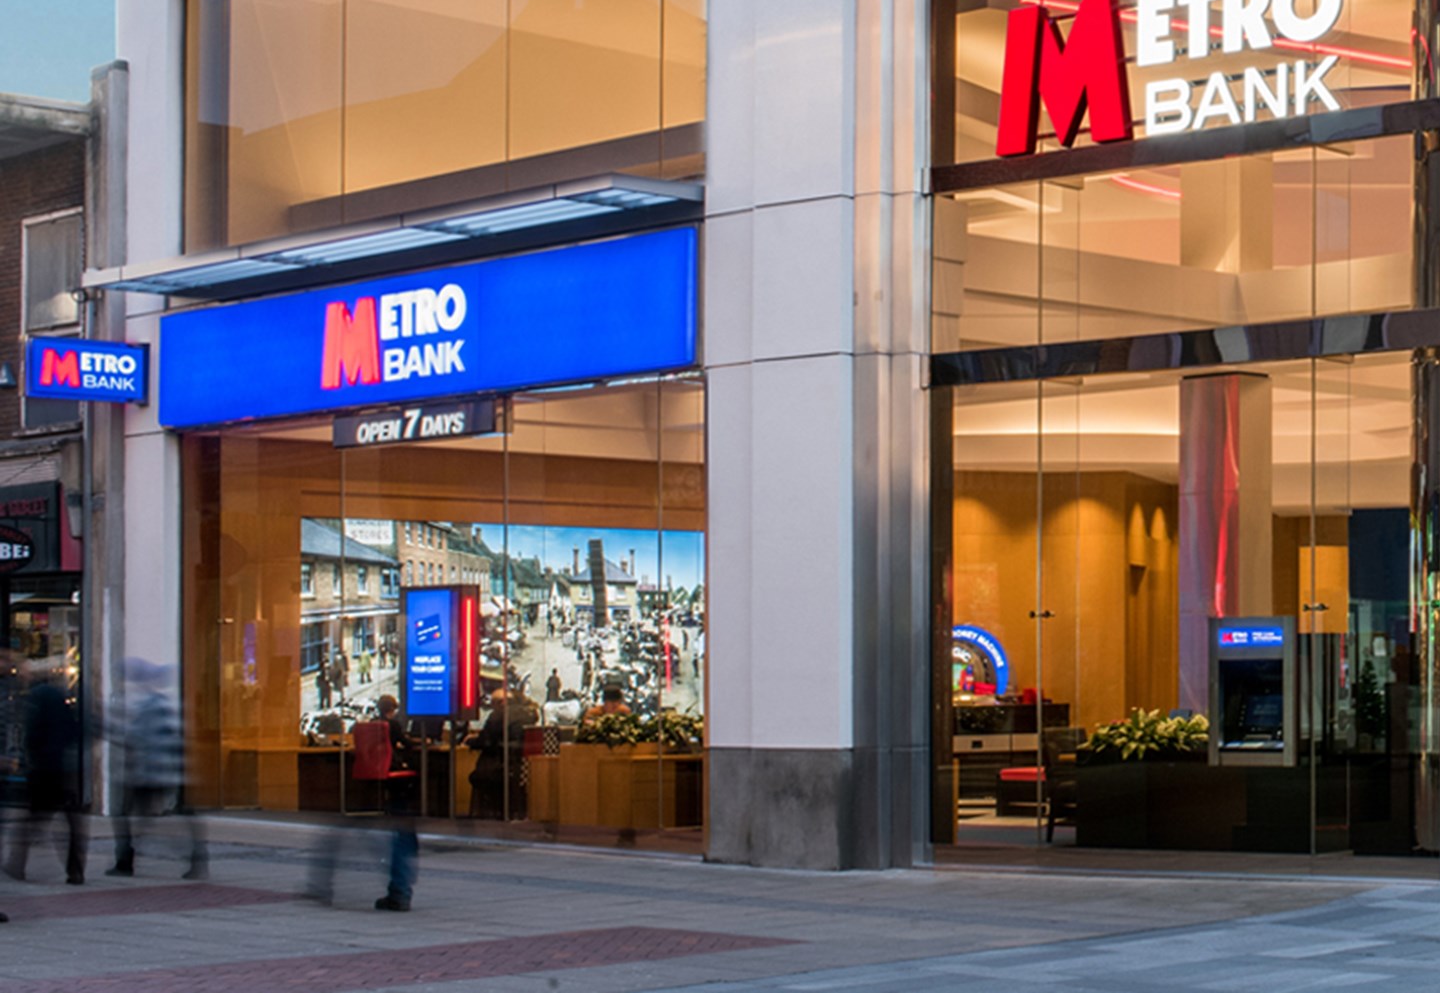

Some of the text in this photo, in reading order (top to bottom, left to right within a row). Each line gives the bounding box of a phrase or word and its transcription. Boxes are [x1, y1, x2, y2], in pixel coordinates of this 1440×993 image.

[1145, 55, 1341, 136] BANK
[320, 283, 467, 390] METRO
[39, 349, 136, 388] METRO
[383, 339, 465, 382] BANK
[82, 374, 135, 391] BANK
[356, 409, 465, 444] OPEN 7 DAYS
